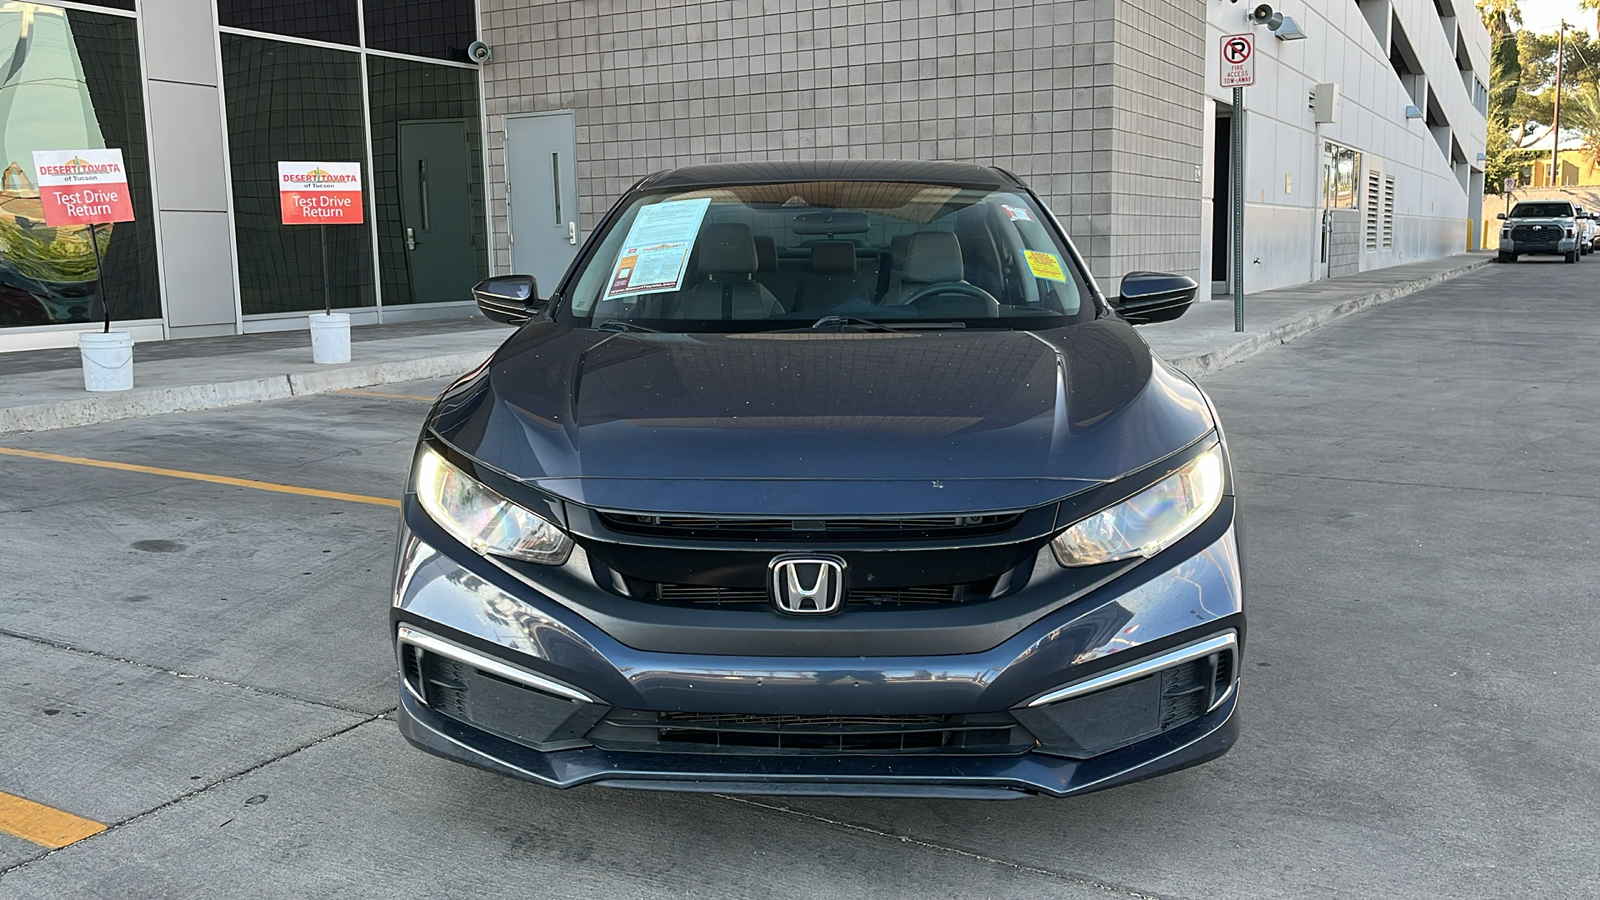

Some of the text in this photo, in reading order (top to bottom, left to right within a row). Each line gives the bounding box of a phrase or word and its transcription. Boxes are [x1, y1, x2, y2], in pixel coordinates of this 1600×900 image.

[40, 164, 120, 175] DESERT TOYOTA
[283, 174, 357, 182] DESERT TOYOTA
[53, 190, 118, 205] Test Drive
[292, 196, 351, 207] Test Drive
[67, 204, 111, 217] Return
[303, 207, 343, 217] Return
